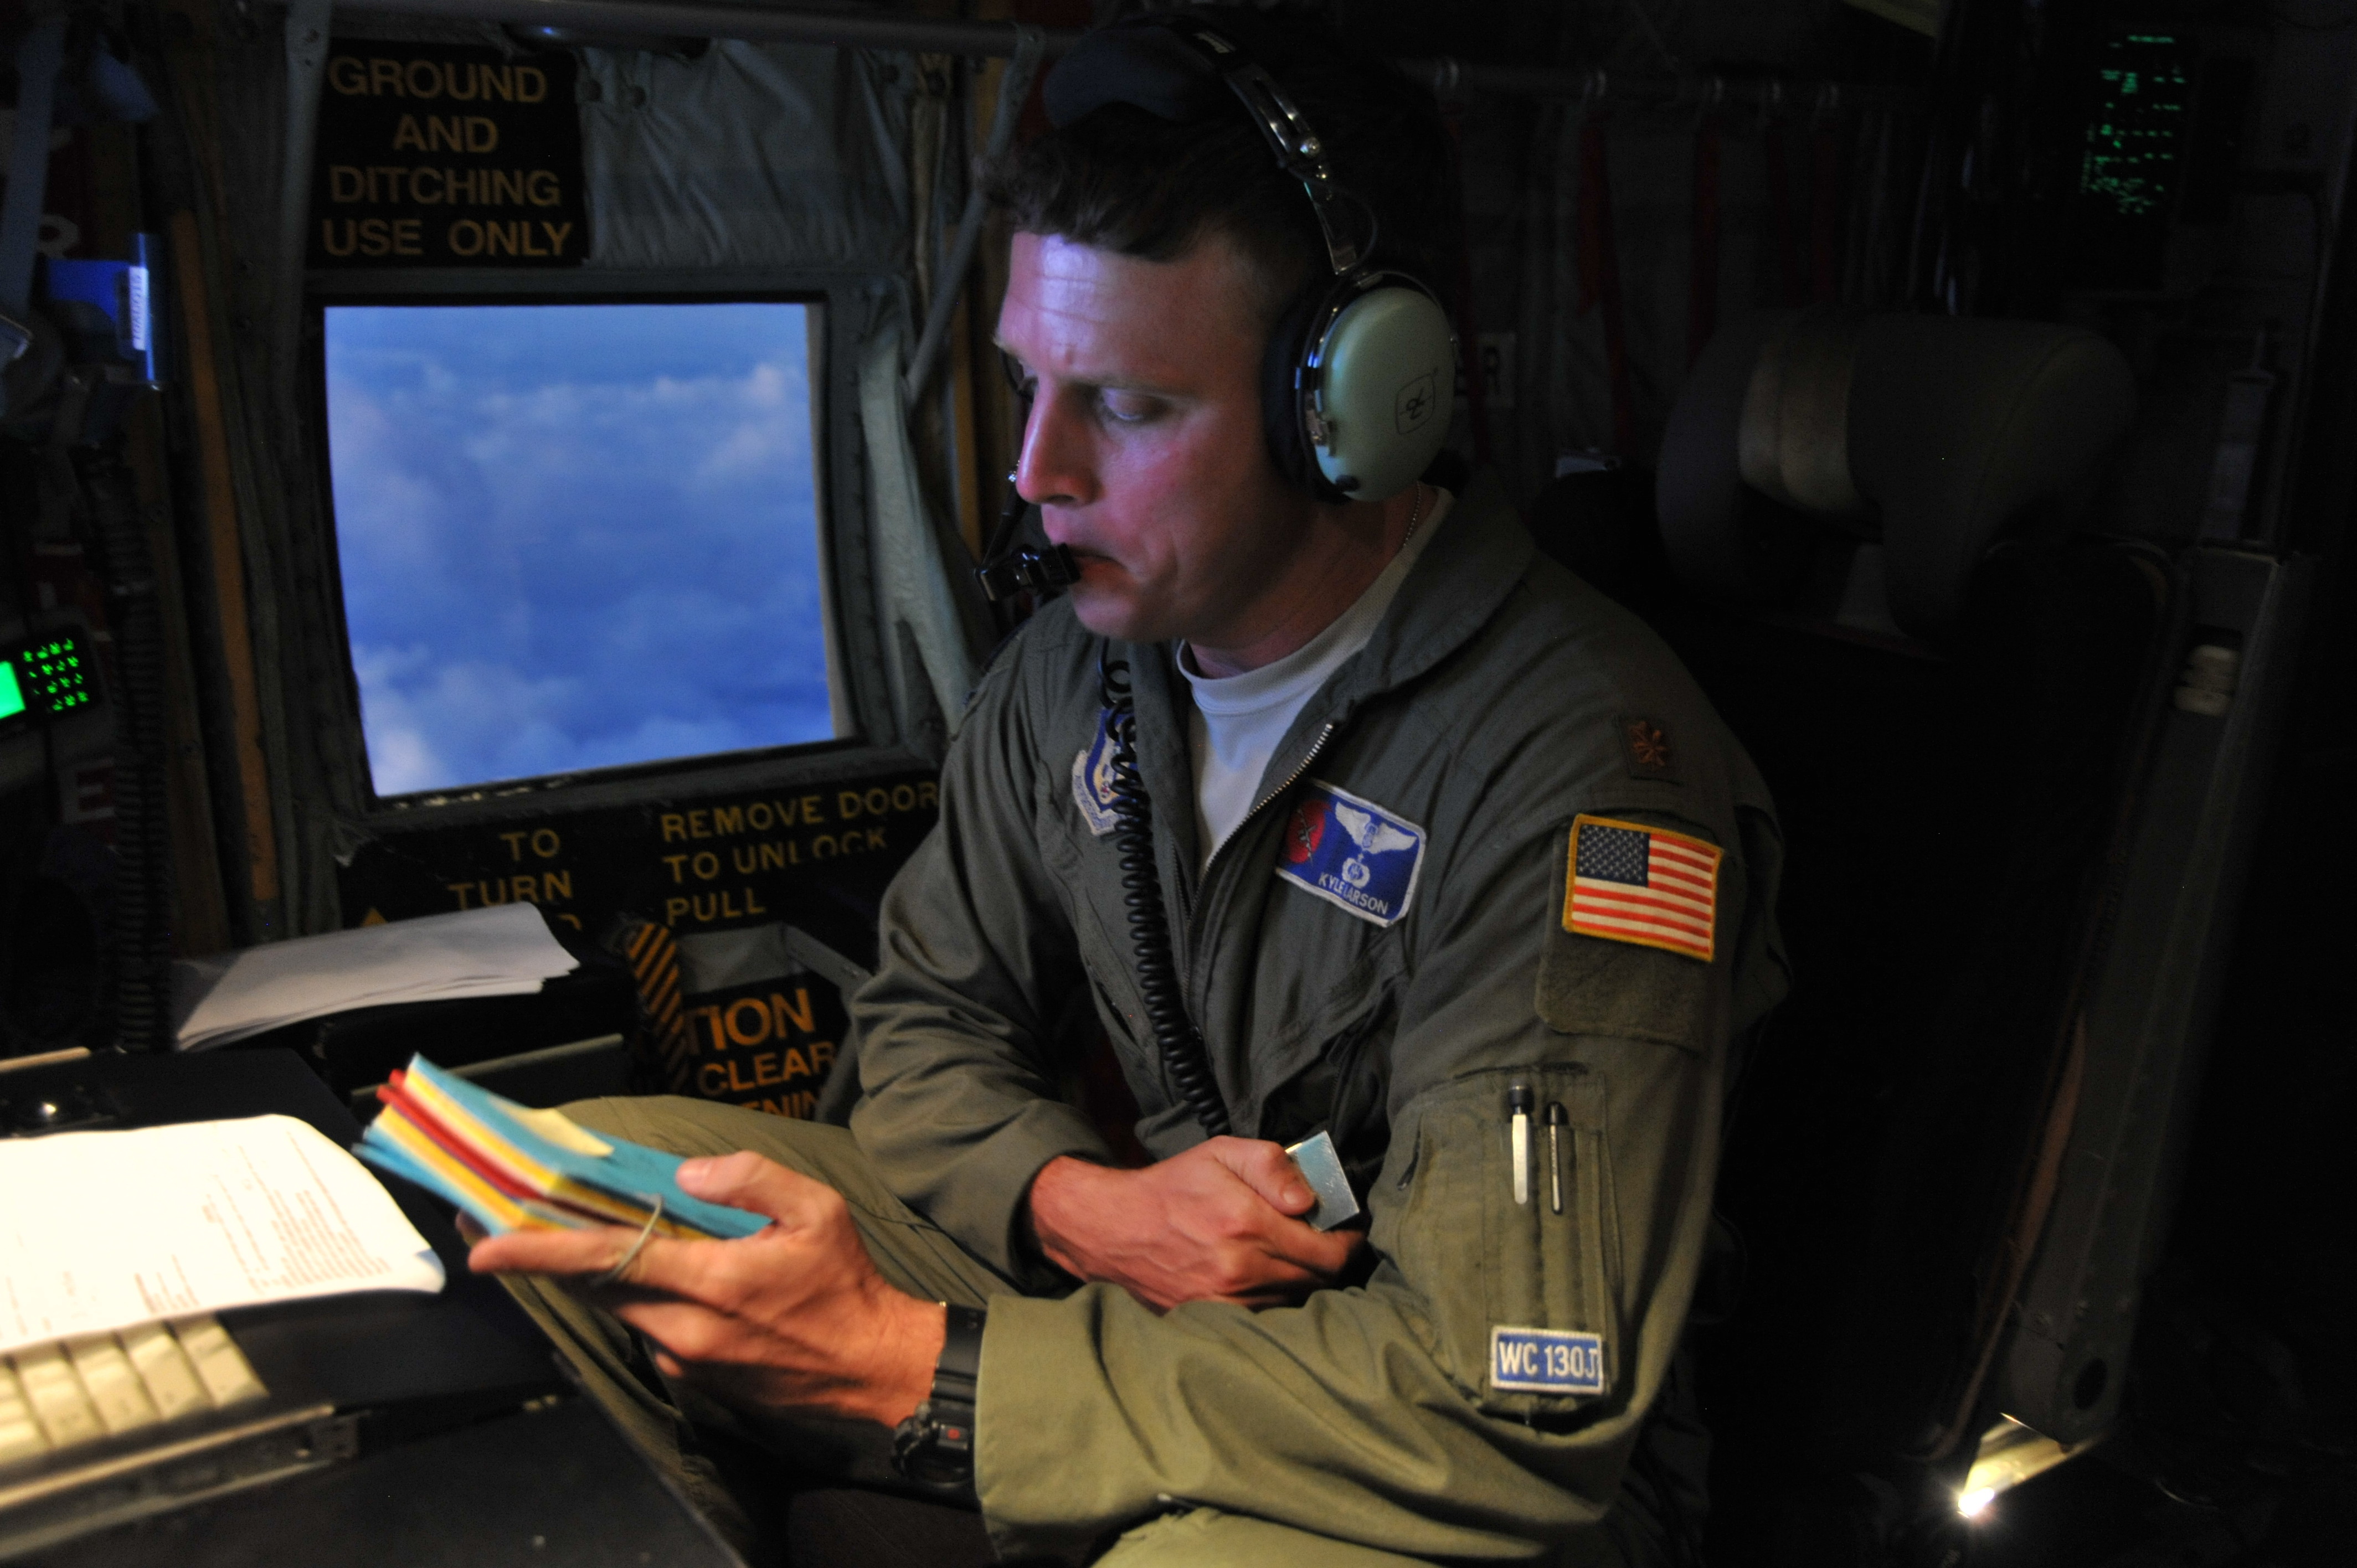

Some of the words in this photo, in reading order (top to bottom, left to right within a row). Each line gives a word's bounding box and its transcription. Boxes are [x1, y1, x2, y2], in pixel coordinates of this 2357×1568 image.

[331, 56, 548, 103] GROUND
[393, 114, 498, 153] AND
[332, 166, 561, 206] DITCHING
[323, 219, 423, 256] USE
[449, 219, 572, 256] ONLY
[661, 795, 825, 843] REMOVE
[837, 780, 939, 821] DOOR
[500, 828, 562, 862] TO
[662, 850, 721, 885] TO
[447, 870, 574, 911] TURN
[666, 886, 767, 926] PULL
[697, 1040, 836, 1097] CLEAR
[1499, 1342, 1538, 1376] WC
[1544, 1345, 1598, 1379] 130J
